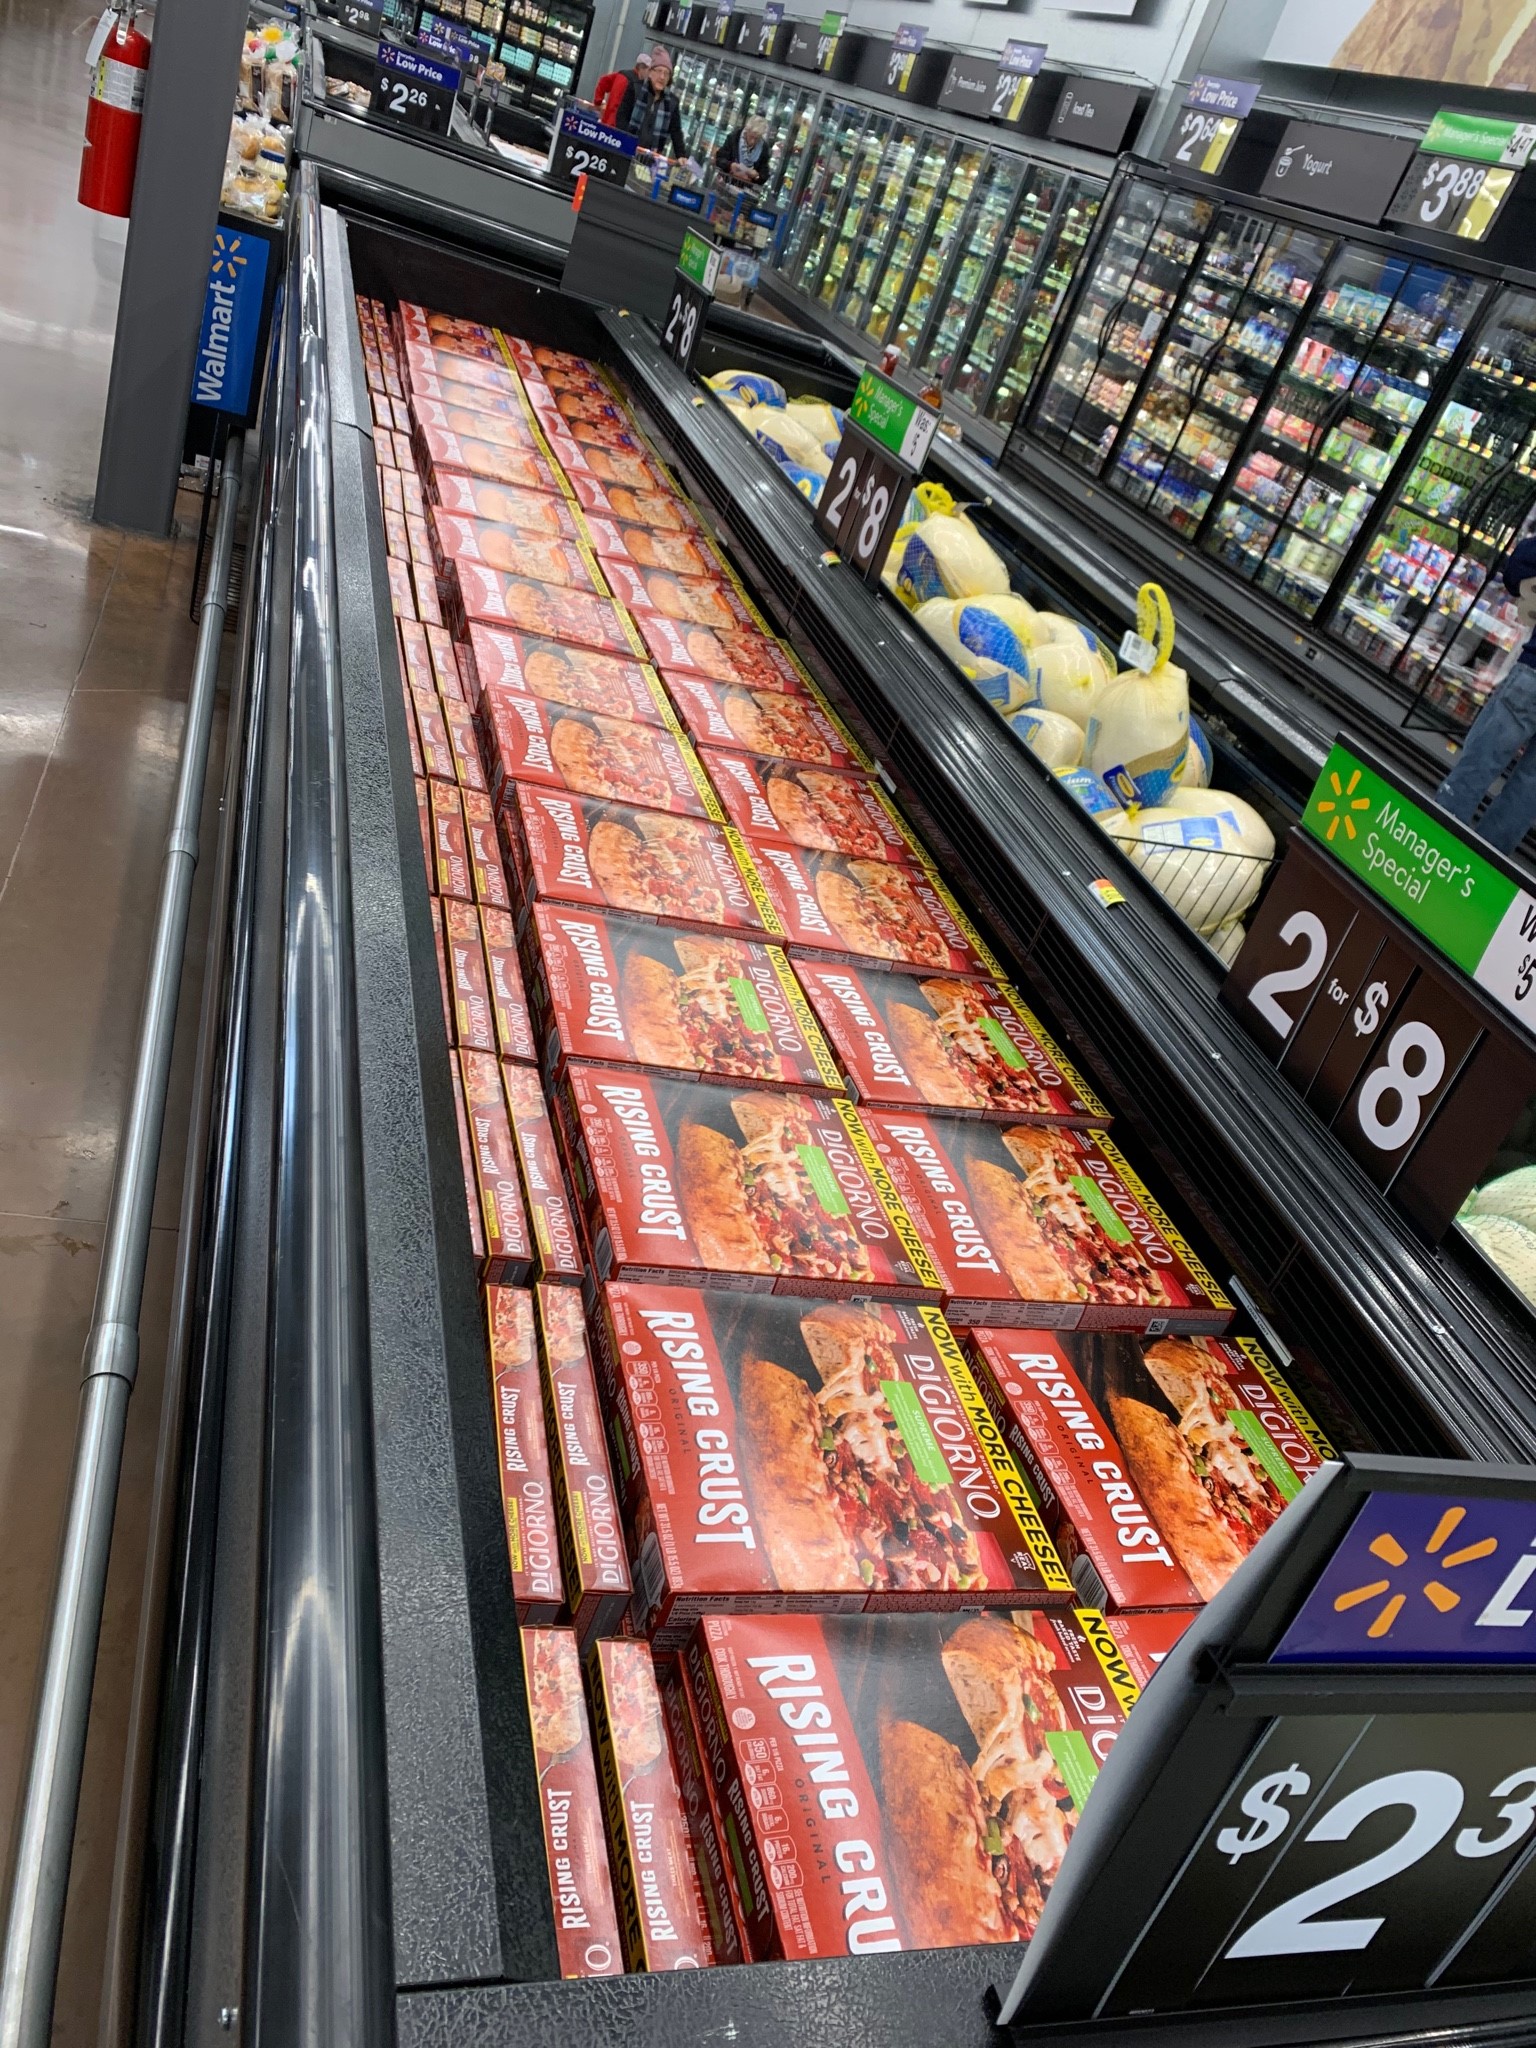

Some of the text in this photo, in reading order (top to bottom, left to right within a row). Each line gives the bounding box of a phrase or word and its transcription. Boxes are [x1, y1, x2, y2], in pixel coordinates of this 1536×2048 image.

[396, 55, 443, 82] Low Price
[1200, 87, 1239, 108] Low Price
[577, 124, 622, 149] Low Price
[1302, 152, 1334, 176] Yogurt
[195, 280, 236, 402] Walmart
[665, 293, 682, 344] 2
[825, 457, 857, 529] 2
[503, 695, 554, 774] RISING CRUST
[716, 757, 780, 832] RISING CRUST
[536, 796, 593, 890] RISING CRUST
[705, 840, 750, 908] DIGIORNO
[726, 826, 766, 897] NOW MORE
[1361, 833, 1431, 905] Special
[1374, 800, 1477, 899] Manager's
[759, 847, 833, 937] RISING CRUST
[914, 885, 969, 951] DIGIORNO
[555, 918, 626, 1042] RISING CRUST
[748, 965, 803, 1052] DIGIORNO
[1247, 909, 1329, 1040] 2
[1327, 977, 1350, 1007] for
[468, 994, 490, 1047] DIGIORNO
[508, 1002, 531, 1056] DIGIORNO
[769, 946, 843, 1088] NOW with MORE CHEESE!
[816, 972, 912, 1089] RISING CRUST
[991, 1004, 1062, 1087] DIGIORNO
[1001, 982, 1108, 1118] NOW MORE CHEESE!
[475, 1116, 500, 1176] RISING CRUST
[520, 1131, 550, 1191] RISING CRUST
[595, 1083, 685, 1242] RISING CRUST
[815, 1127, 889, 1241] DIGIORNO
[496, 1179, 525, 1254] DIGIORNO
[545, 1195, 575, 1269] DIGIORNO
[839, 1101, 938, 1288] NOW with MORE CHEESE!
[882, 1122, 1002, 1276] RISING CRUST
[1084, 1158, 1173, 1265] DIGIORNO
[1095, 1132, 1232, 1309] NOW with MORE CHEESE!
[621, 1265, 665, 1276] Nutrition Facts
[500, 1385, 529, 1473] RISING CRUST
[559, 1381, 591, 1467] RISING CRUST
[637, 1309, 720, 1419] RISING
[695, 1428, 757, 1550] CRUST
[668, 1388, 692, 1454] ORIGINAL
[904, 1353, 1001, 1519] DIGIORNO
[912, 1408, 936, 1452] SUPREME
[1242, 1342, 1288, 1390] NOW
[1278, 1390, 1310, 1426] with
[1304, 1428, 1338, 1462] MO
[923, 1310, 1070, 1592] NOW with MORE CHEESE!
[1007, 1353, 1106, 1450] RISING
[1092, 1461, 1175, 1567] CRUST
[1009, 1422, 1056, 1511] RISING CRUST
[1057, 1424, 1094, 1485] ORIGINAL
[1260, 1435, 1291, 1474] SUPREME
[522, 1481, 554, 1593] DIGIORNO
[586, 1475, 624, 1584] DIGIORNO
[706, 1619, 723, 1642] PIZZA
[713, 1647, 728, 1665] COOK
[1056, 1618, 1083, 1662] BAKED TASTE
[1066, 1628, 1082, 1650] FRESH
[1082, 1616, 1137, 1690] NOW
[1107, 1620, 1125, 1640] PIZZA
[688, 1644, 727, 1785] DIGIORNO
[718, 1663, 738, 1701] THOROUGHLY
[752, 1739, 767, 1760] 350
[774, 1756, 784, 1772] PIZZA
[746, 1654, 860, 1821] RISING
[834, 1839, 903, 1956] CRU
[795, 1778, 832, 1884] ORIGINAL
[547, 1787, 591, 1931] RISING CRUST
[603, 1748, 619, 1824] with
[613, 1823, 642, 1948] MORE
[629, 1800, 679, 1942] RISING CRUST
[727, 1777, 770, 1923] RISING CRUST
